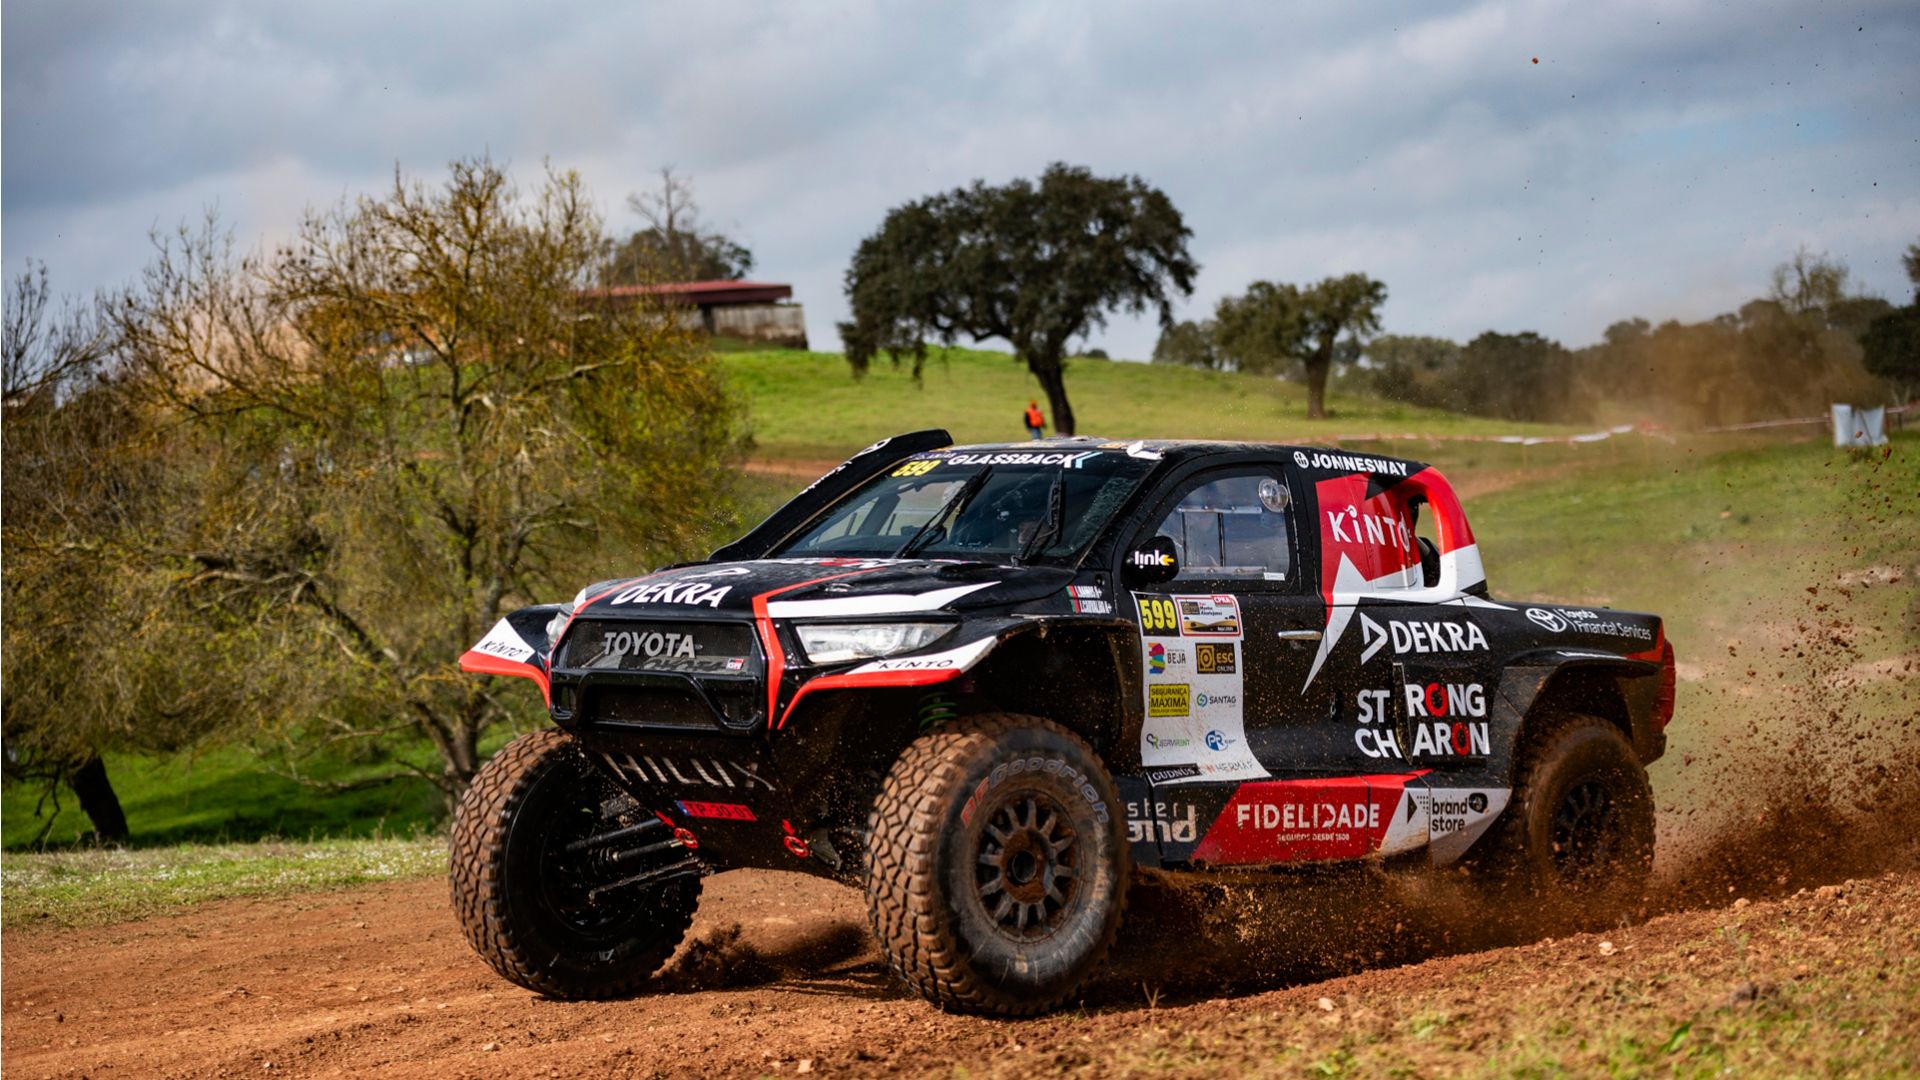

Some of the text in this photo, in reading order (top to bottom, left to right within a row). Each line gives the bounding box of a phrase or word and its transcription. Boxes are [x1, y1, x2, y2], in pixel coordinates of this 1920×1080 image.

[891, 460, 941, 477] 599
[948, 451, 1092, 469] GLASSBACK
[1311, 453, 1408, 476] JONNESWAY
[610, 582, 733, 608] DEKRA
[1138, 598, 1177, 630] 599
[1558, 609, 1598, 620] Toyota
[1389, 620, 1490, 654] DEKRA
[1573, 620, 1652, 640] Financial Services
[604, 631, 697, 659] TOYOTA
[1167, 652, 1186, 664] BEJA
[1216, 652, 1234, 664] ESC
[1432, 798, 1467, 815] brand
[1237, 803, 1380, 830] FIDELIDADE
[1432, 817, 1465, 832] store
